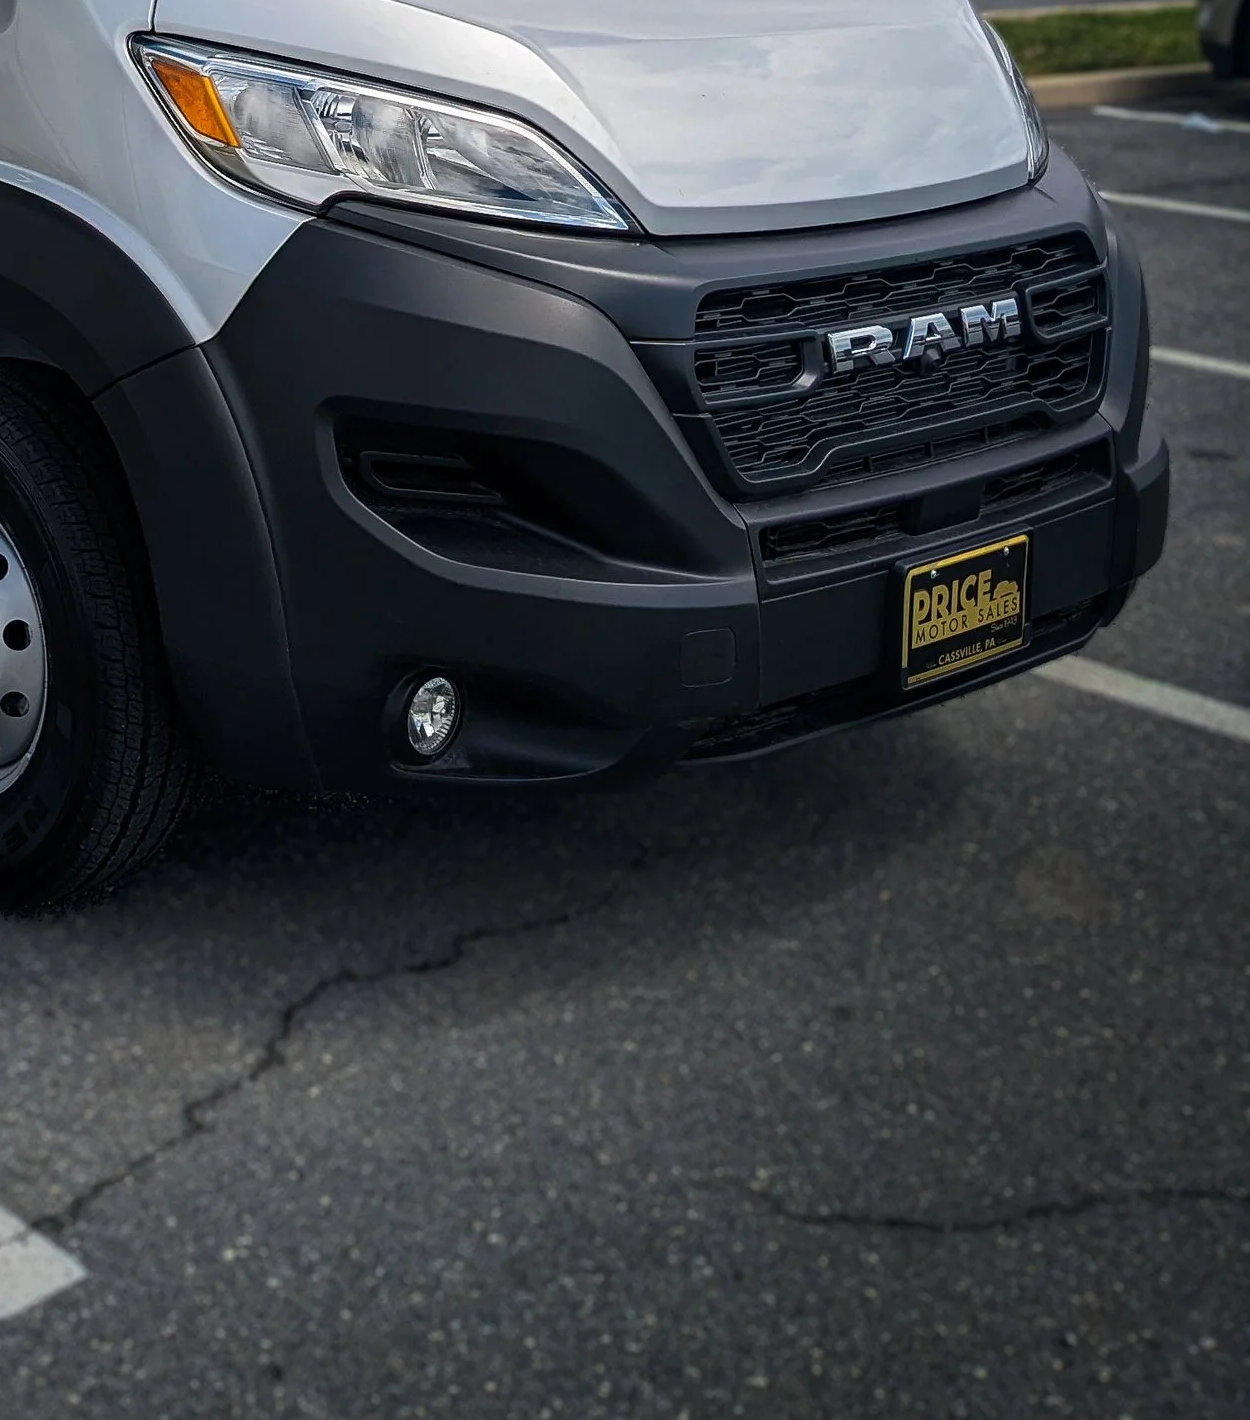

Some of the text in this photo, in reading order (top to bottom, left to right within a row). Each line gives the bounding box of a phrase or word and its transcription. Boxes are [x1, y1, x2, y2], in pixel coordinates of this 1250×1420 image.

[827, 297, 1022, 375] RAM
[913, 569, 992, 626] PRICE
[915, 597, 1018, 645] MOTOR SALES
[938, 642, 983, 665] CASSVILLE,
[985, 637, 996, 650] PA
